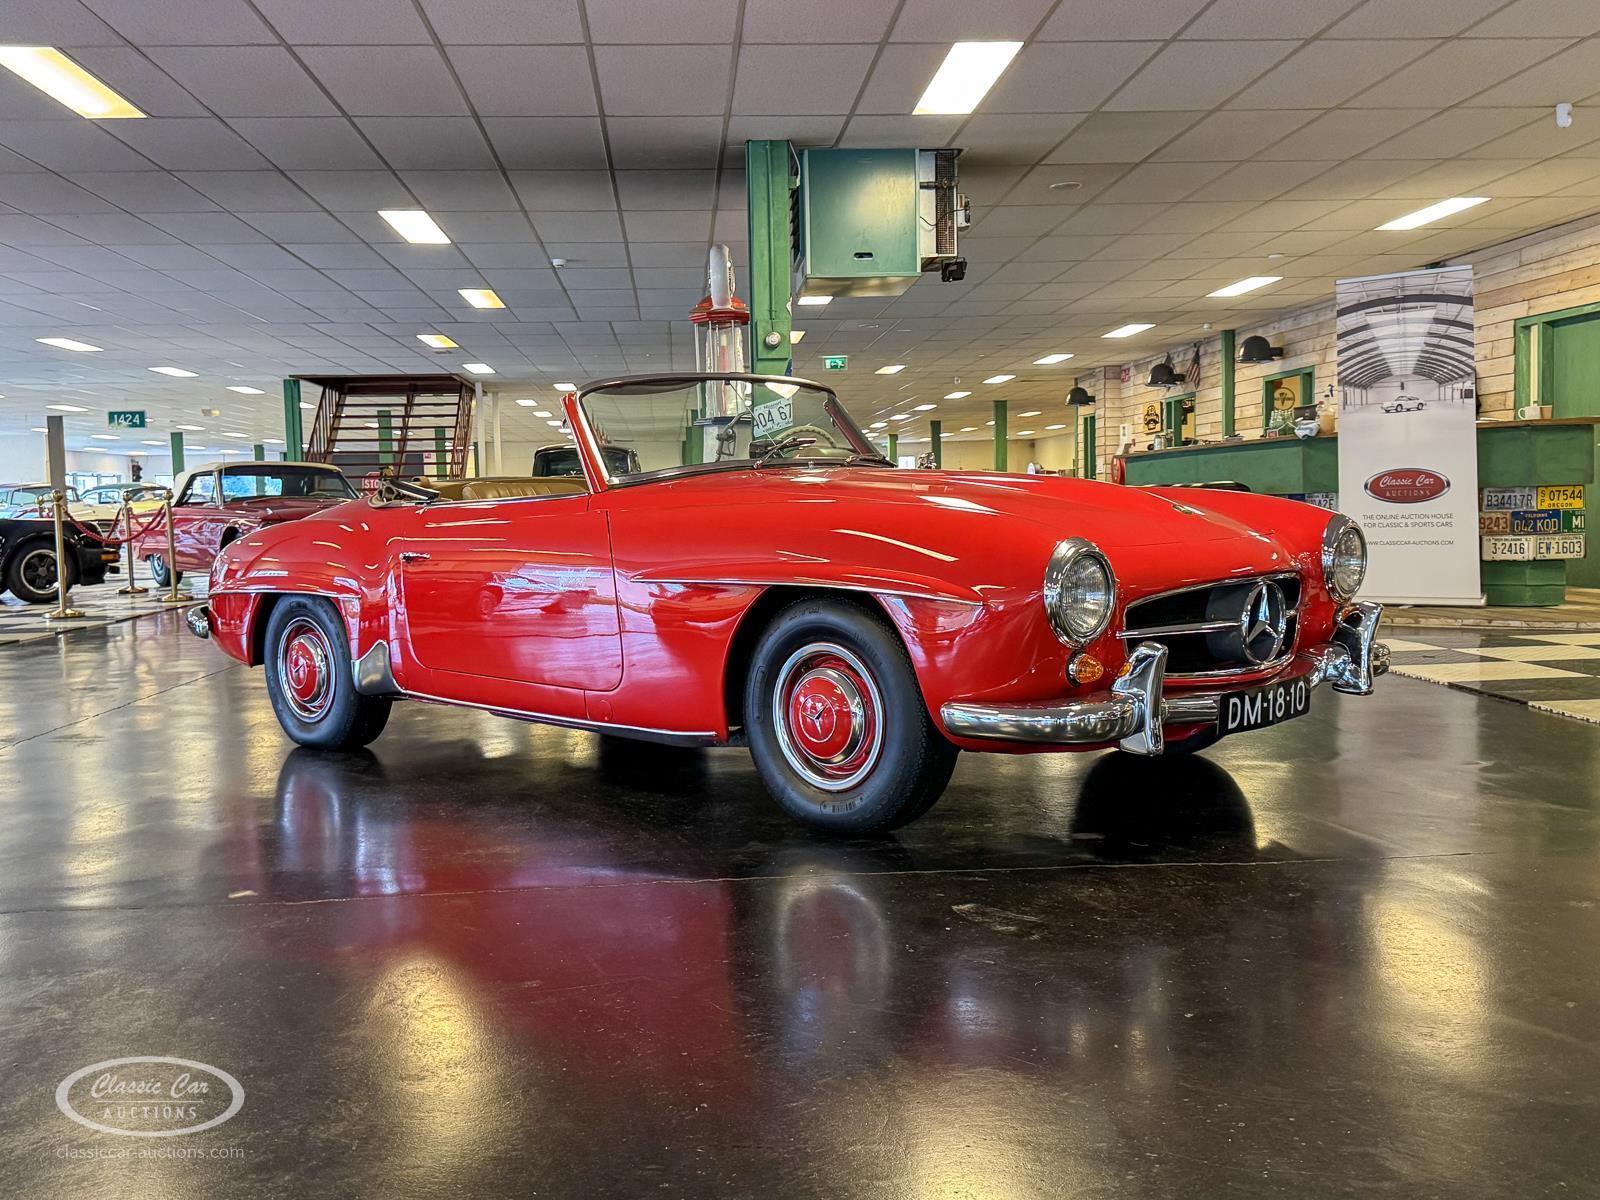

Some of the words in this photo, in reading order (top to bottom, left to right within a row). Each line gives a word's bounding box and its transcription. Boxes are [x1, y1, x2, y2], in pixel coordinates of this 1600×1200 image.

[113, 413, 140, 425] 1424
[364, 479, 381, 489] STO
[1379, 475, 1412, 488] Classic
[1415, 474, 1435, 487] Car
[1385, 489, 1431, 497] AUCTIONS
[1548, 489, 1583, 502] 07544
